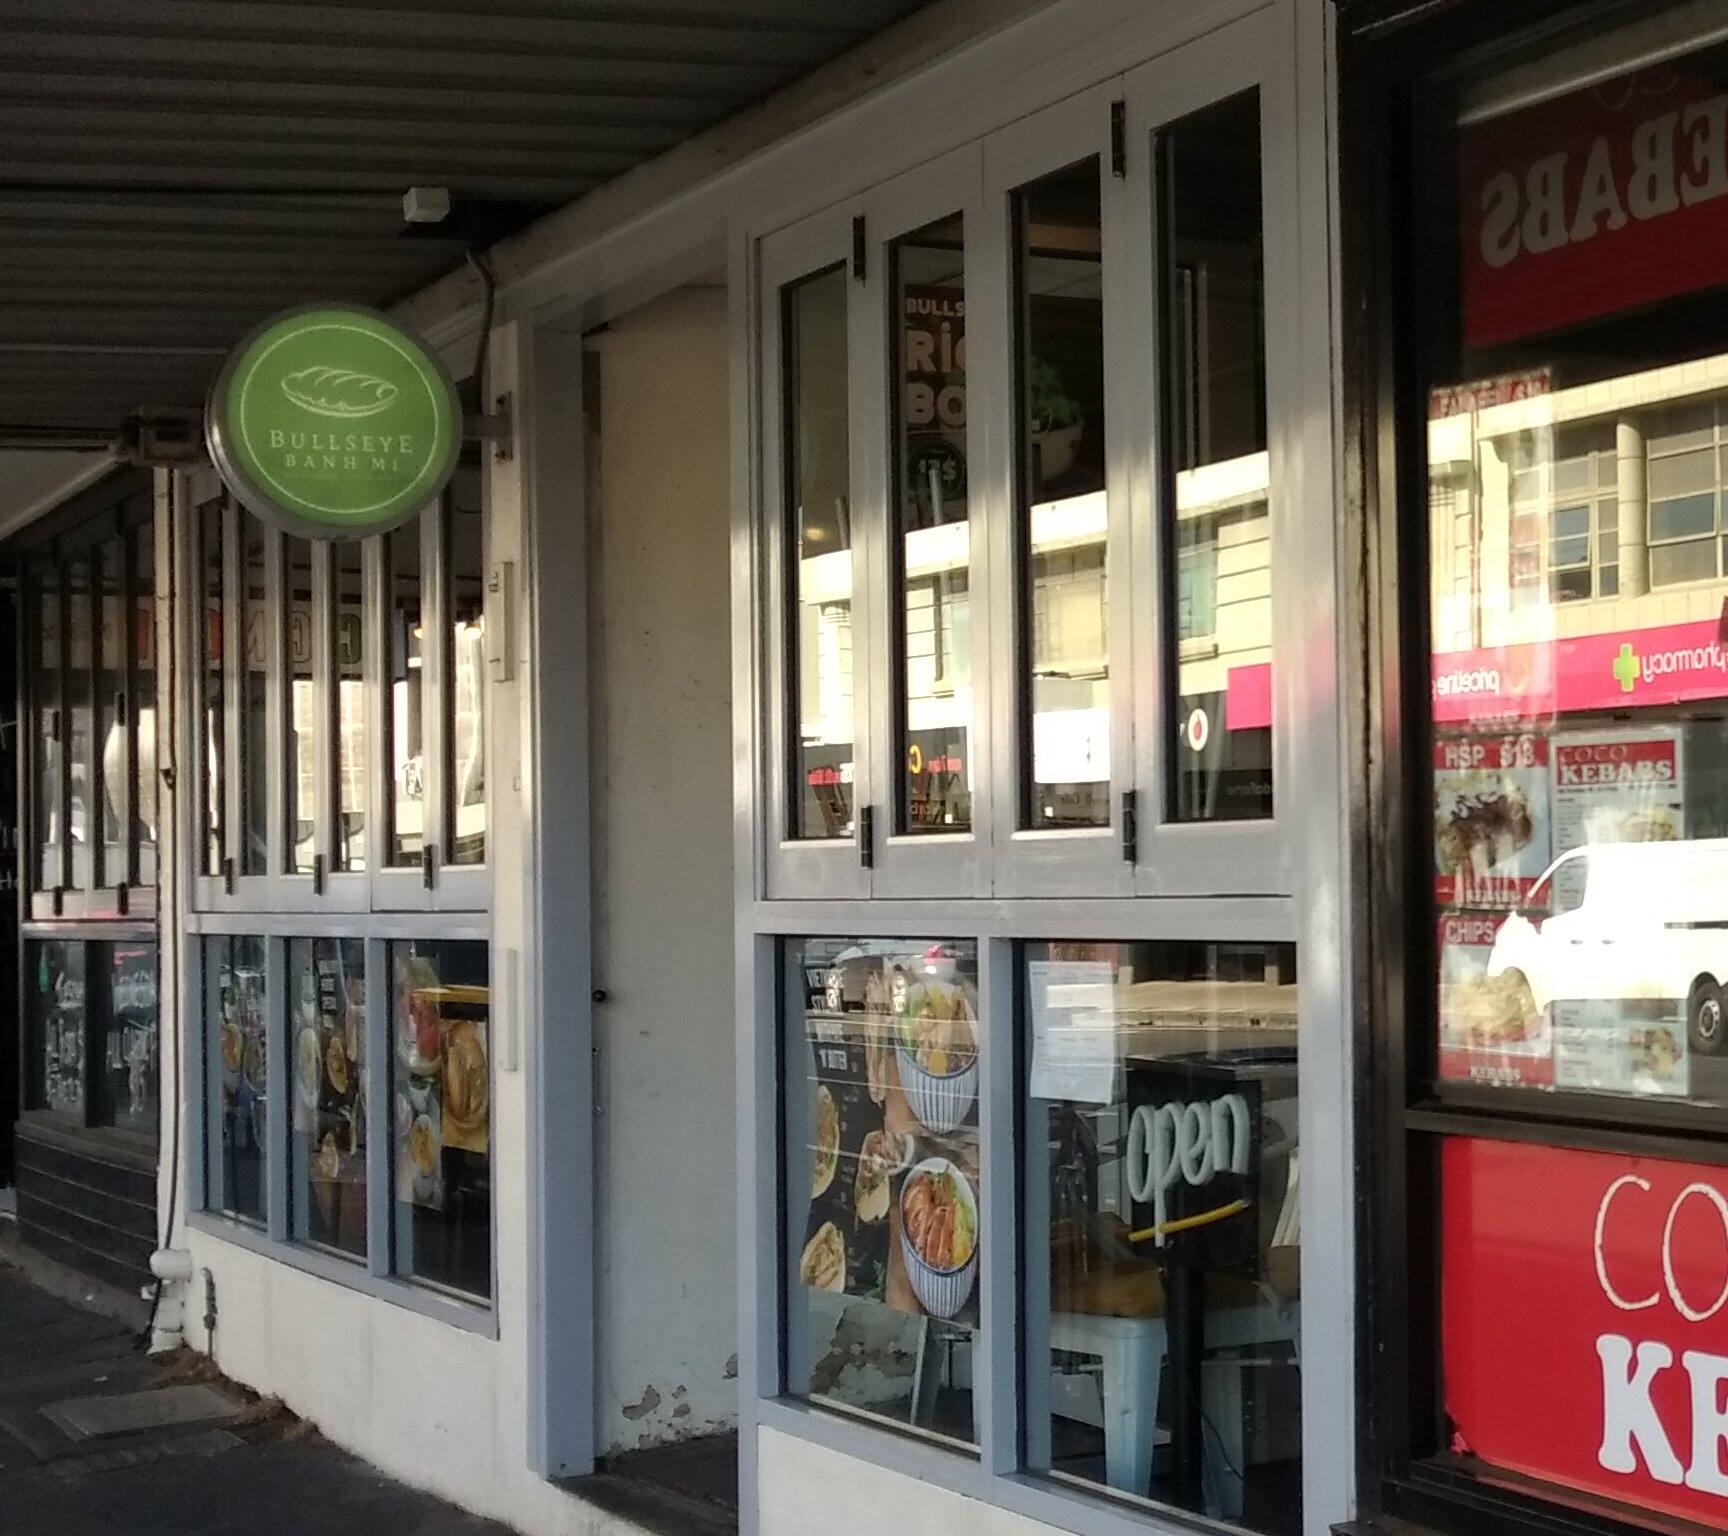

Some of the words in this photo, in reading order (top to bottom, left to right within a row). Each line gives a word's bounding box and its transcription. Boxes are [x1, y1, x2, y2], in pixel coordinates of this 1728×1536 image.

[269, 428, 414, 454] BULLSEYE
[284, 453, 356, 471] BANH
[1562, 760, 1673, 785] KEBABS
